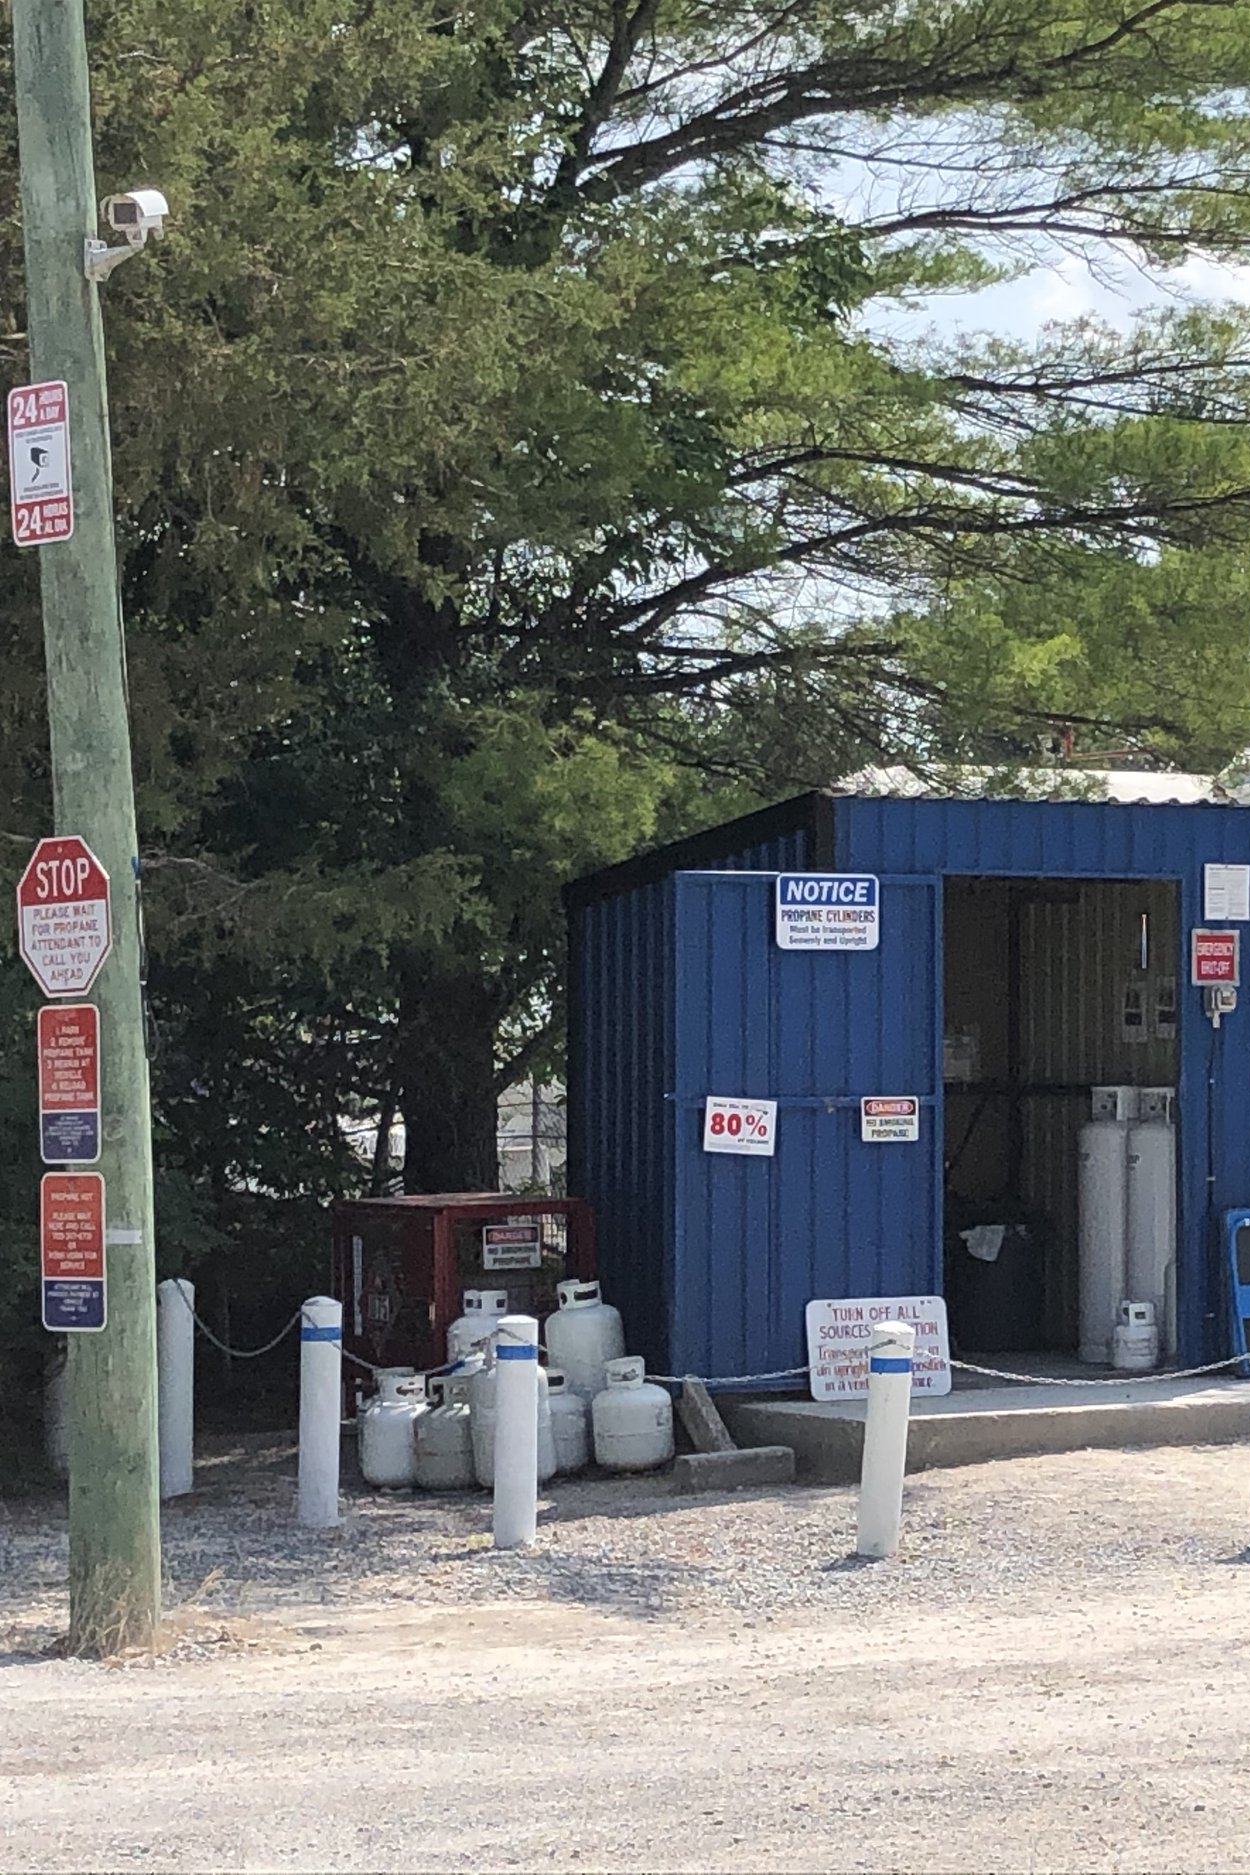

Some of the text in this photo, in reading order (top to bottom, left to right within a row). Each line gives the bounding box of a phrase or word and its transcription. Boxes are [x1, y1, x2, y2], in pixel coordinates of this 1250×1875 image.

[13, 393, 38, 426] 24
[18, 506, 42, 538] 24
[36, 857, 90, 899] STOP
[786, 880, 870, 903] NOTICE
[33, 904, 96, 920] PLEASE WAIT
[781, 909, 876, 923] PROPANE CYLINDERS
[32, 920, 99, 936] FOR PROPANE
[31, 935, 101, 951] ATTENDANT TO
[42, 951, 91, 966] CALL YOU
[51, 968, 83, 982] AHEAD
[710, 1112, 768, 1138] 80%
[832, 1304, 921, 1322] TURN OFF ALL
[819, 1321, 938, 1340] SOURCES TION
